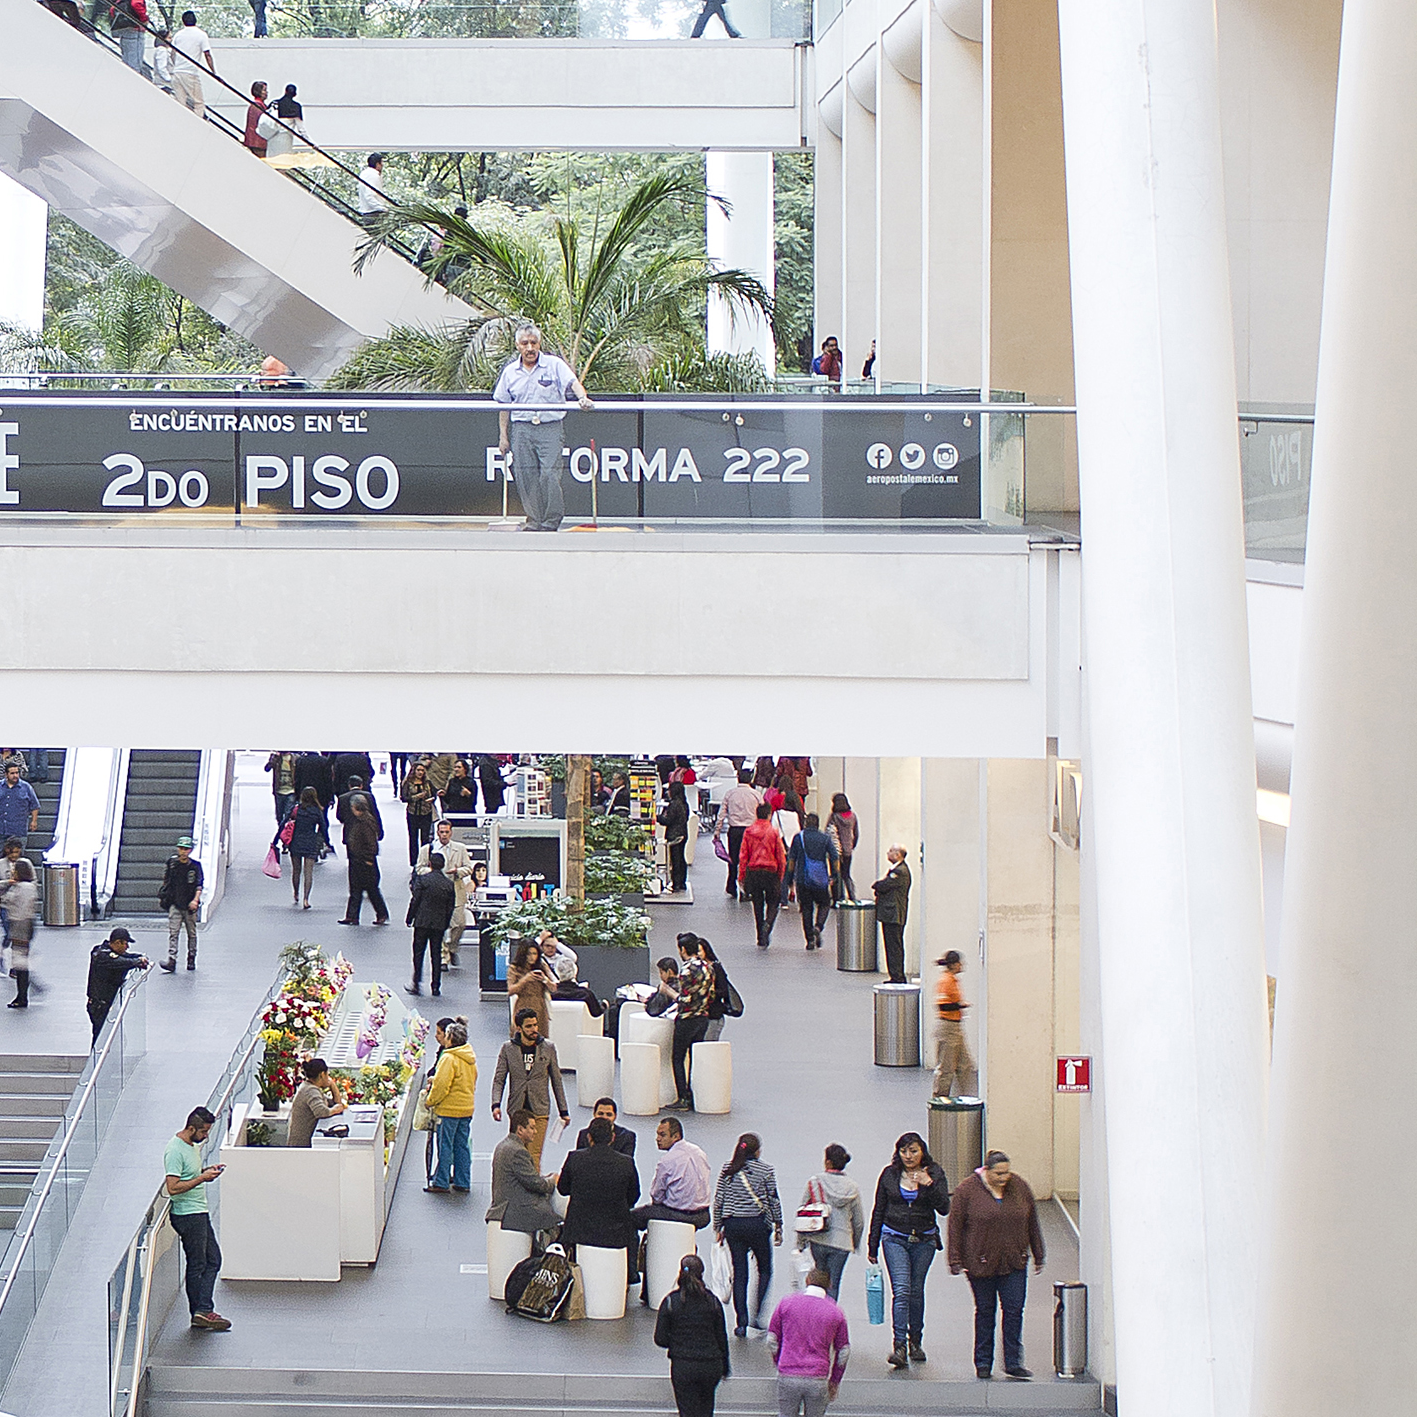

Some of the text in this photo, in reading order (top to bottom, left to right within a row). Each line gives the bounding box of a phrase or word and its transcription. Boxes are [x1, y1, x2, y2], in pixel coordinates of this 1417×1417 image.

[130, 411, 368, 432] ENCUÉNTRANOS EN EL
[486, 447, 810, 482] RORMA 222
[102, 453, 400, 510] 2DO PISO
[866, 473, 959, 485] aeropostalemexico.mx
